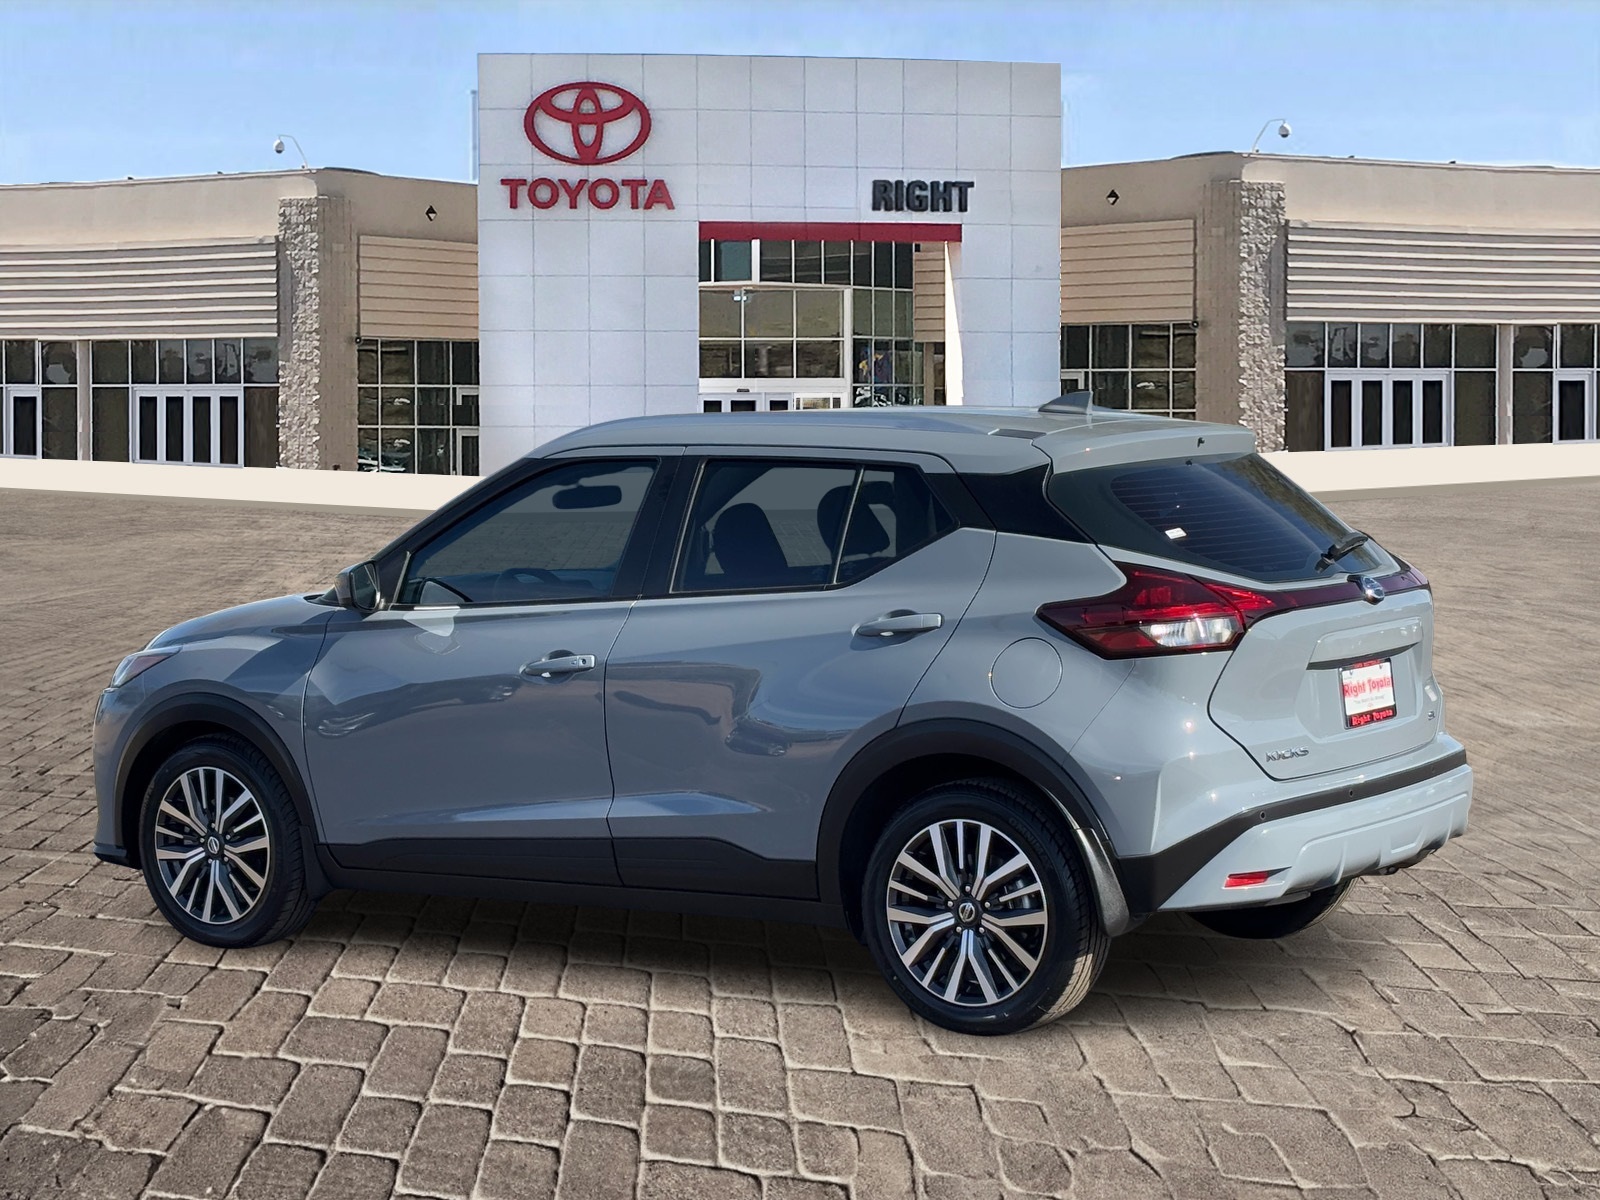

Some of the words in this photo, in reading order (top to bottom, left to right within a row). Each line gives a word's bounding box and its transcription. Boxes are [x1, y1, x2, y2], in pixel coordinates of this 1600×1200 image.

[500, 178, 675, 209] TOYOTA
[872, 180, 975, 212] RIGHT
[1343, 681, 1366, 697] Right
[1368, 677, 1391, 693] Toyota
[1351, 714, 1371, 726] Right
[1373, 709, 1393, 721] Toyota
[1265, 746, 1309, 762] KICKS
